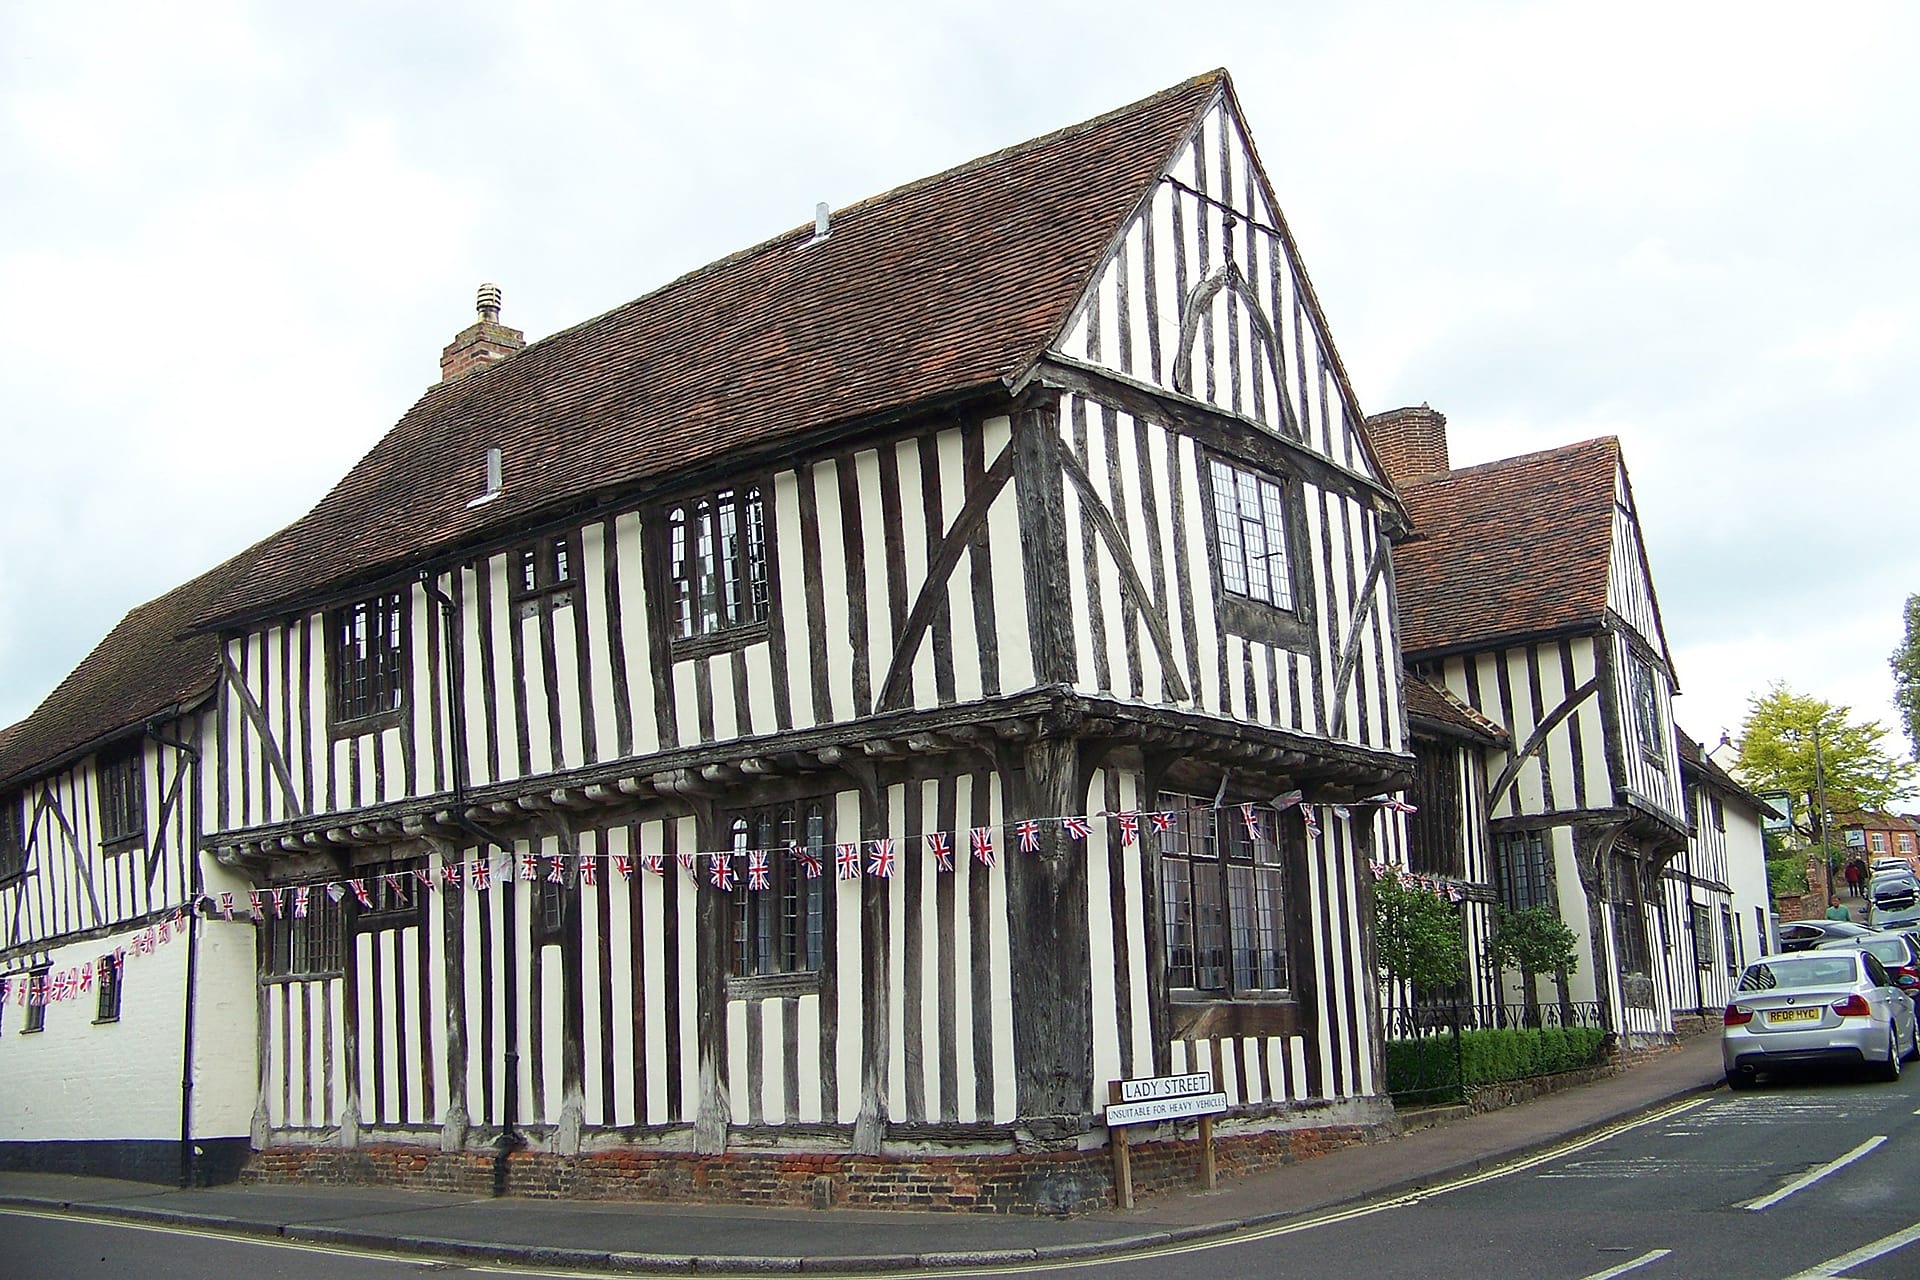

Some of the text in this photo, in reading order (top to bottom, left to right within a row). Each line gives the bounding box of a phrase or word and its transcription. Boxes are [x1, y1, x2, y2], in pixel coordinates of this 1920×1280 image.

[1125, 1076, 1207, 1098] LADY STREET
[1108, 1097, 1225, 1120] UNSUITABLE FOR HEAVY VEHICLES
